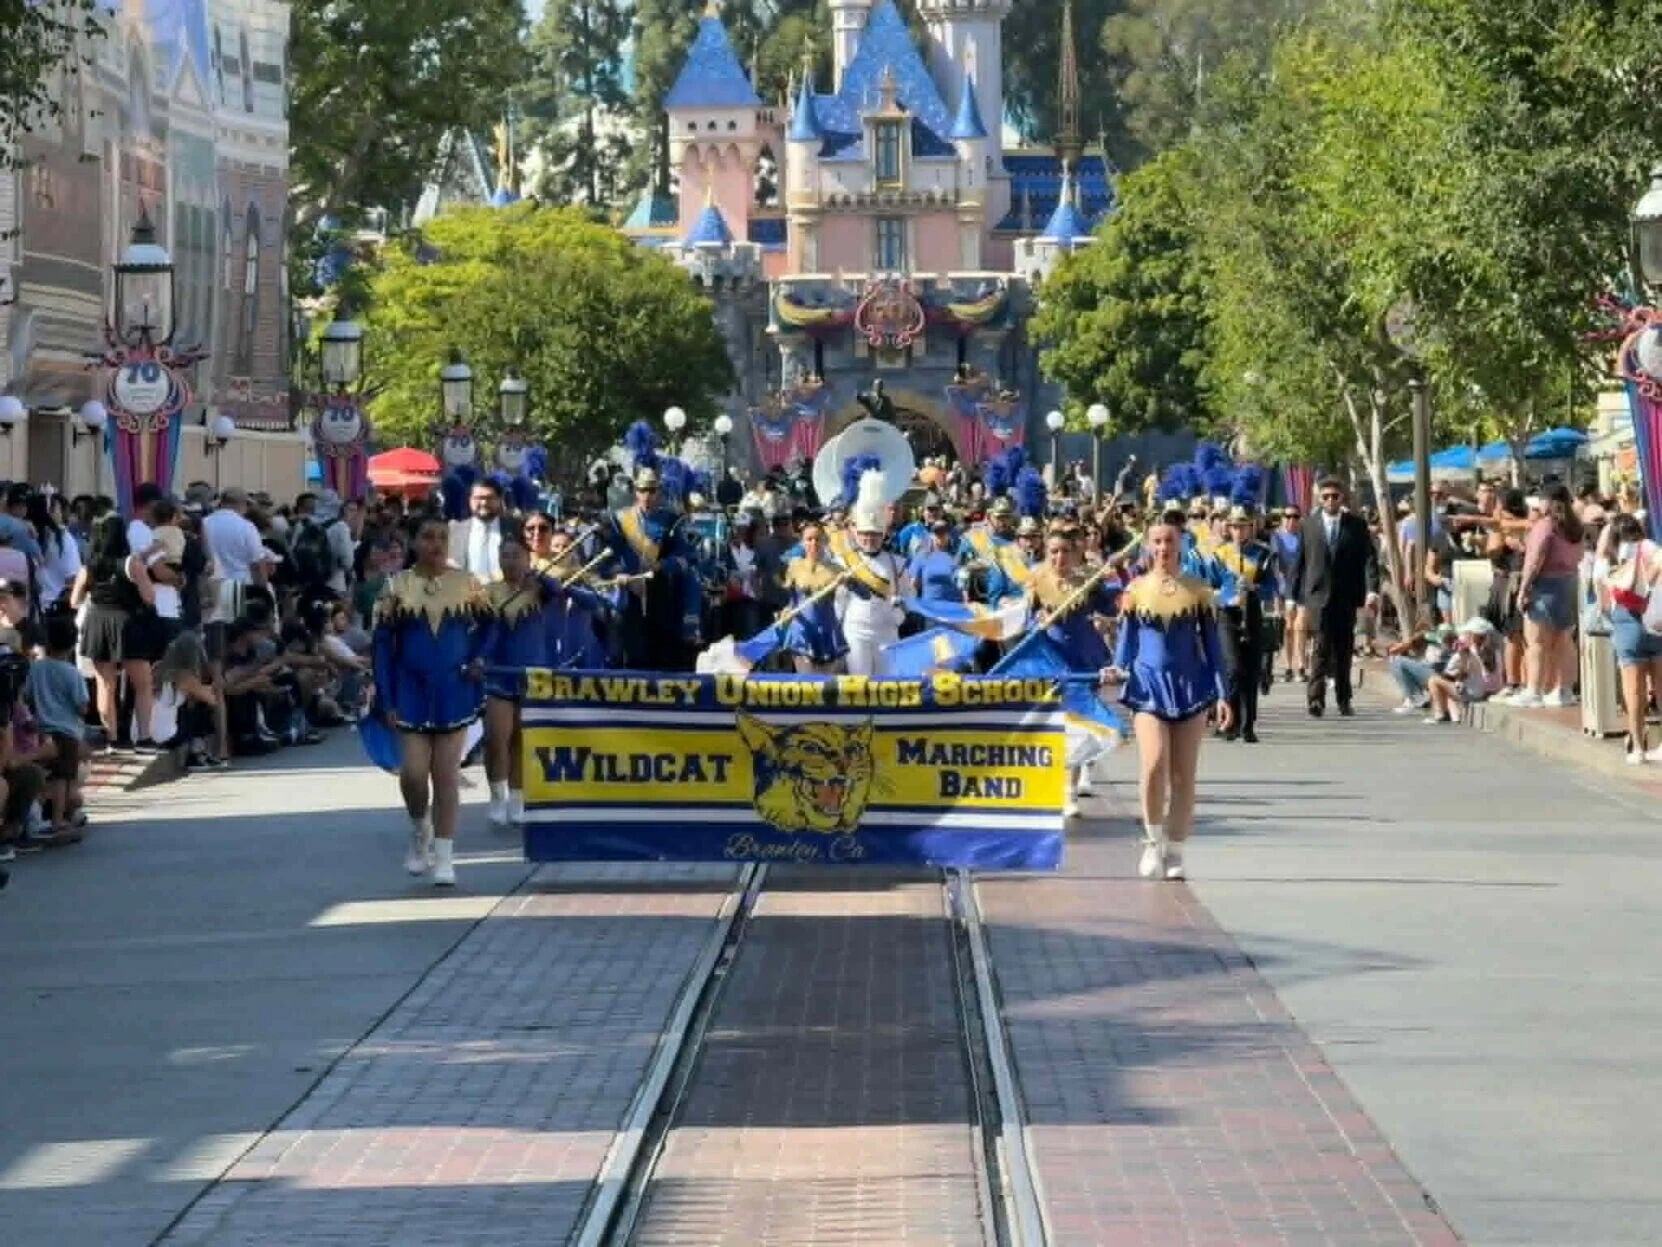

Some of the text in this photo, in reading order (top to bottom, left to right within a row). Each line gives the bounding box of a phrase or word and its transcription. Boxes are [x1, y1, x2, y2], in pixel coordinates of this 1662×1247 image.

[127, 363, 160, 383] 70
[326, 406, 354, 422] 70
[525, 667, 1062, 706] BRAWLEY UNION HIGH SCHOOL
[535, 747, 732, 783] WILDCAT
[896, 738, 1053, 767] MARCHING
[939, 770, 1022, 799] BAND
